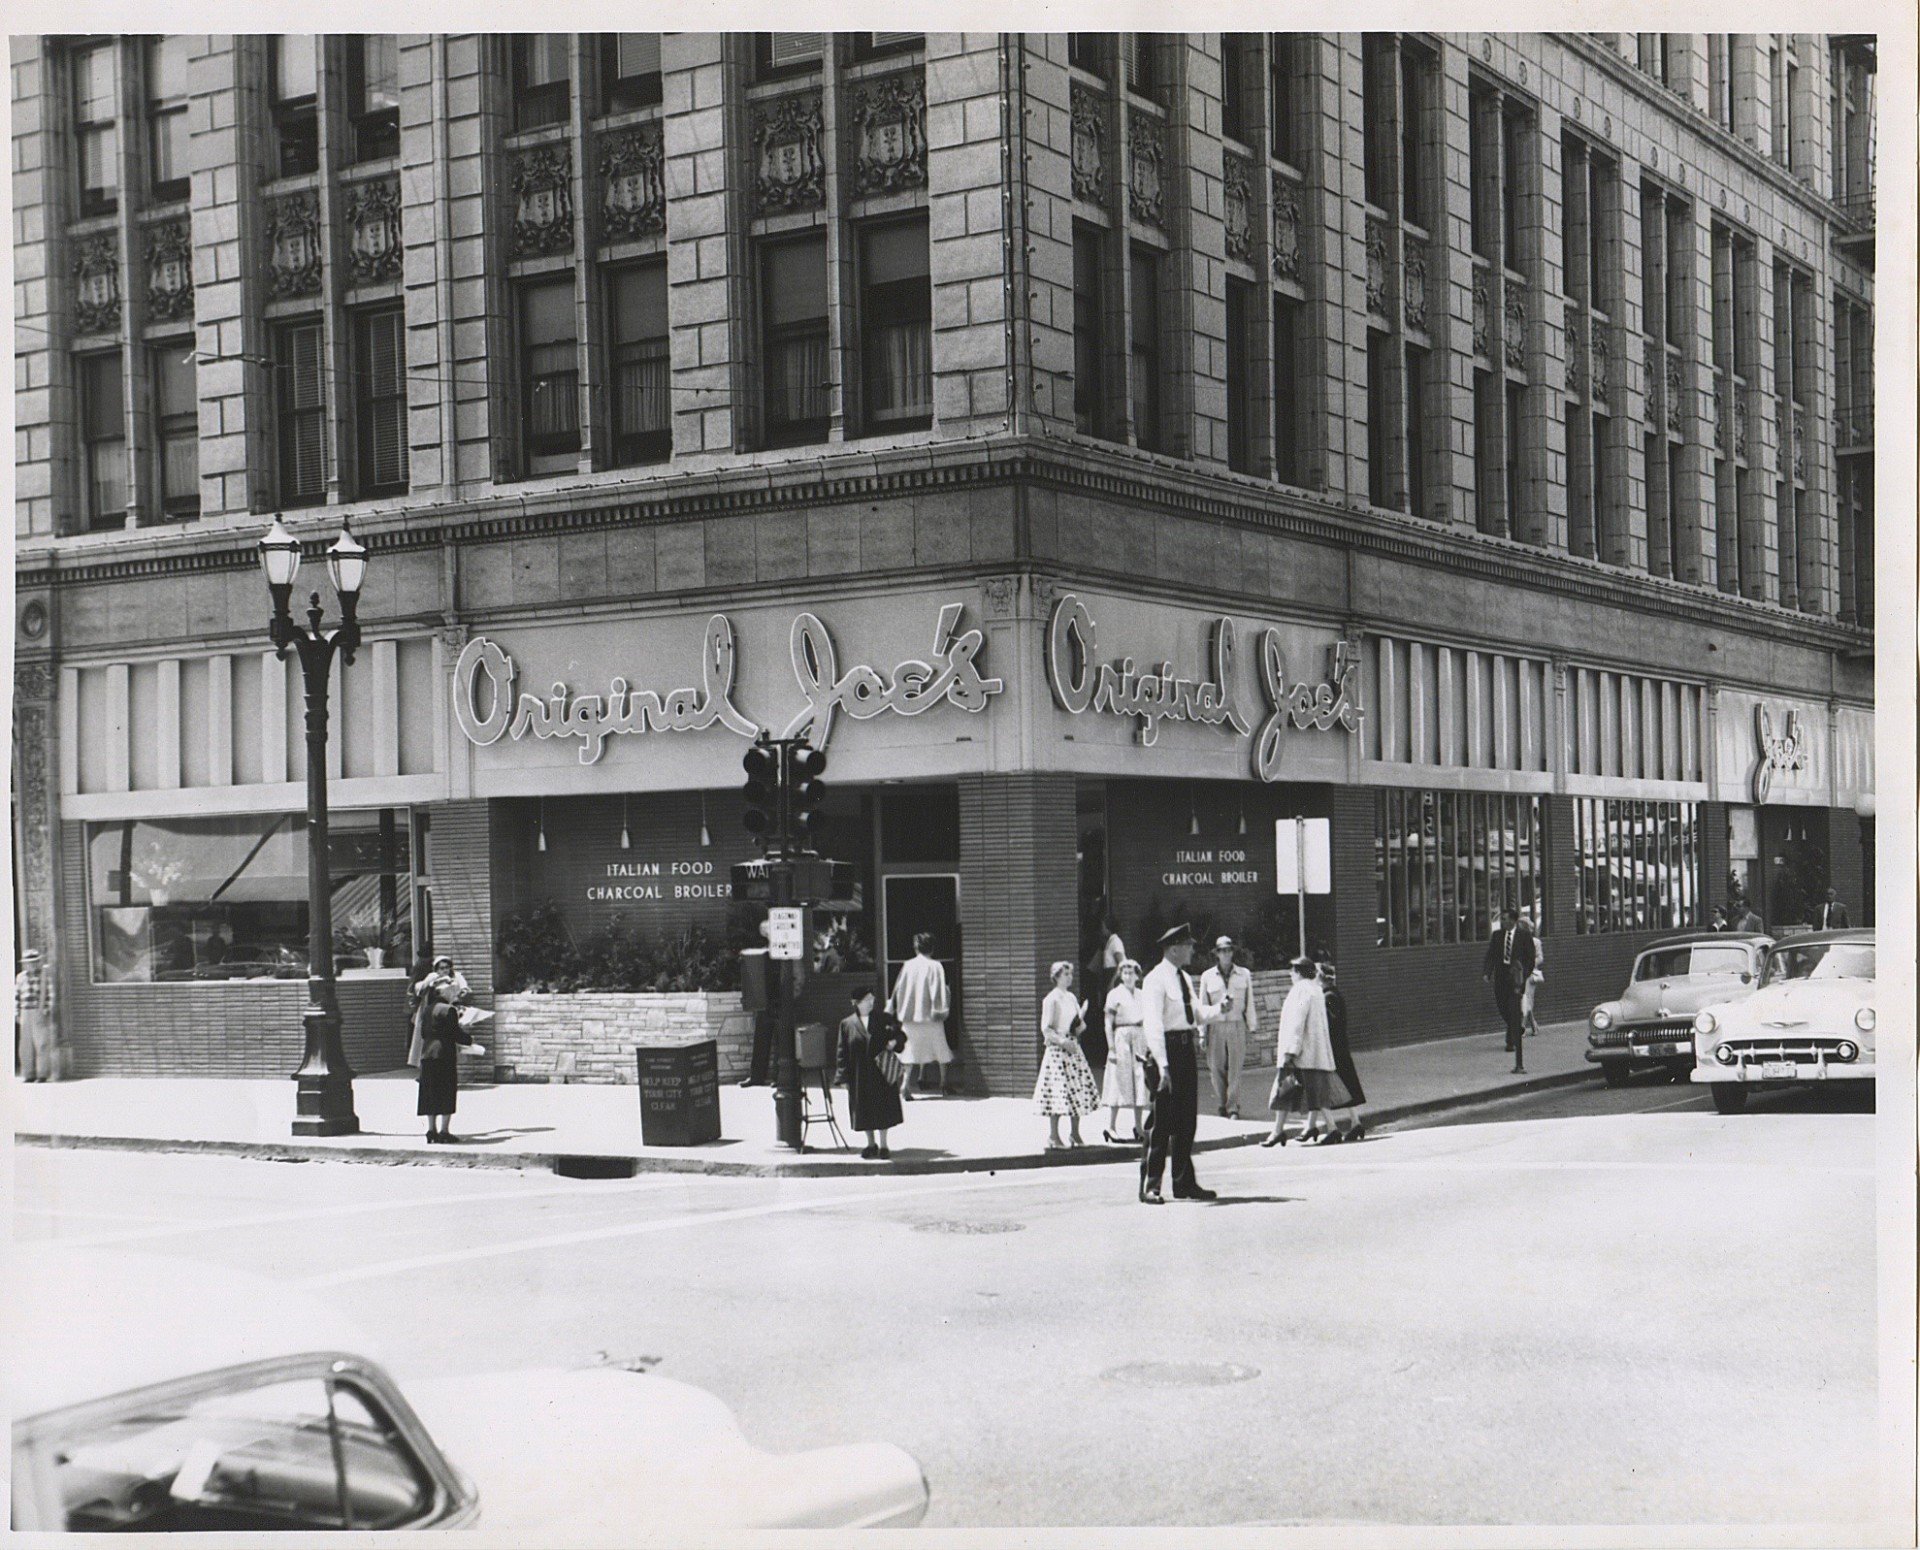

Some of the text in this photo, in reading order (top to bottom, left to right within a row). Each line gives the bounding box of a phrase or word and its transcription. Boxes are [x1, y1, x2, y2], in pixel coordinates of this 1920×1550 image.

[453, 602, 1003, 765] Original Joe's
[1049, 594, 1365, 783] Original Joe's
[1176, 850, 1246, 864] ITALIAN FOOD
[606, 861, 714, 878] ITALIAN FOOD
[1162, 871, 1259, 886] CHARCOAL BROILER
[586, 885, 664, 901] CHARCOAL
[674, 883, 733, 899] BROILER
